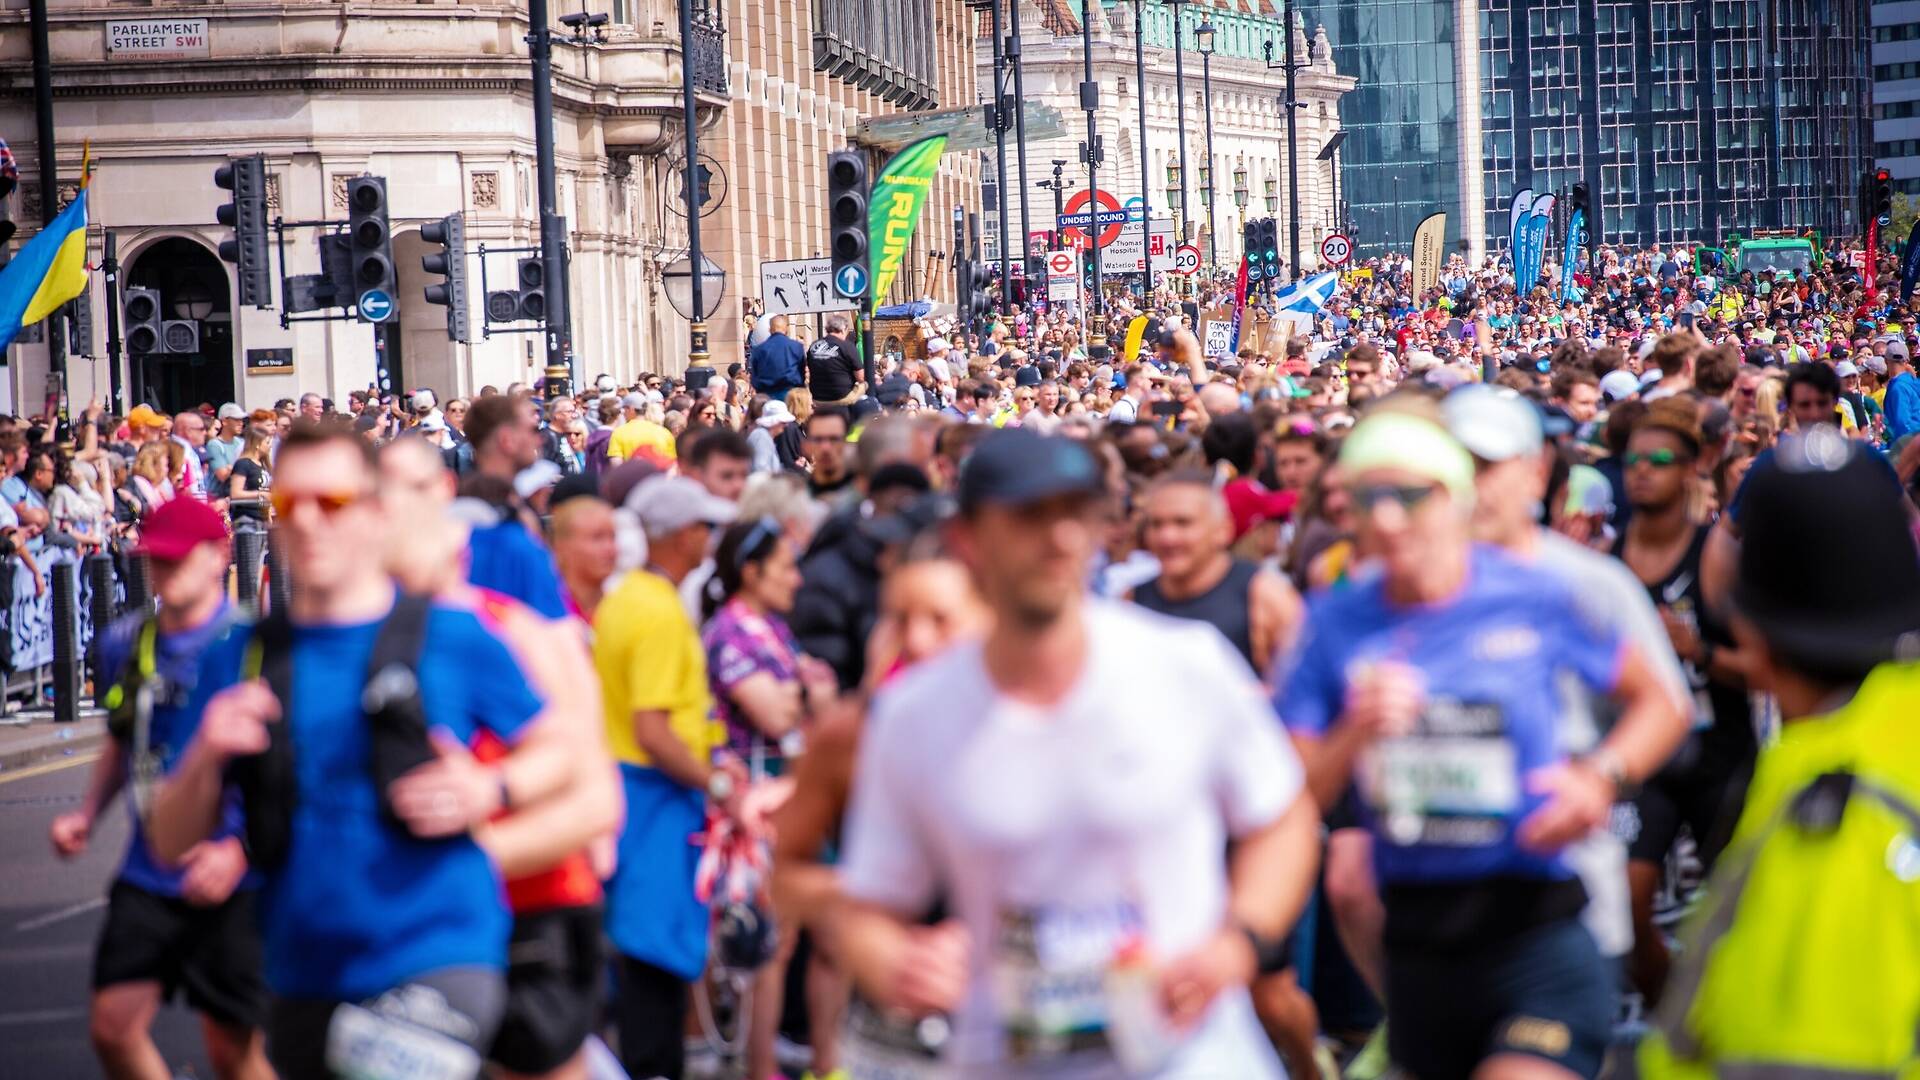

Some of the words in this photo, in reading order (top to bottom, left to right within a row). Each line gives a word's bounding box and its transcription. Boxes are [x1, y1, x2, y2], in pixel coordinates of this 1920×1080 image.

[113, 24, 200, 35] PARLIAMENT
[114, 37, 167, 49] STREET
[175, 36, 202, 47] SW1
[1110, 247, 1138, 255] Hospital
[1326, 243, 1347, 256] 20
[1176, 254, 1196, 267] 20
[811, 265, 831, 273] Water
[780, 271, 794, 280] City
